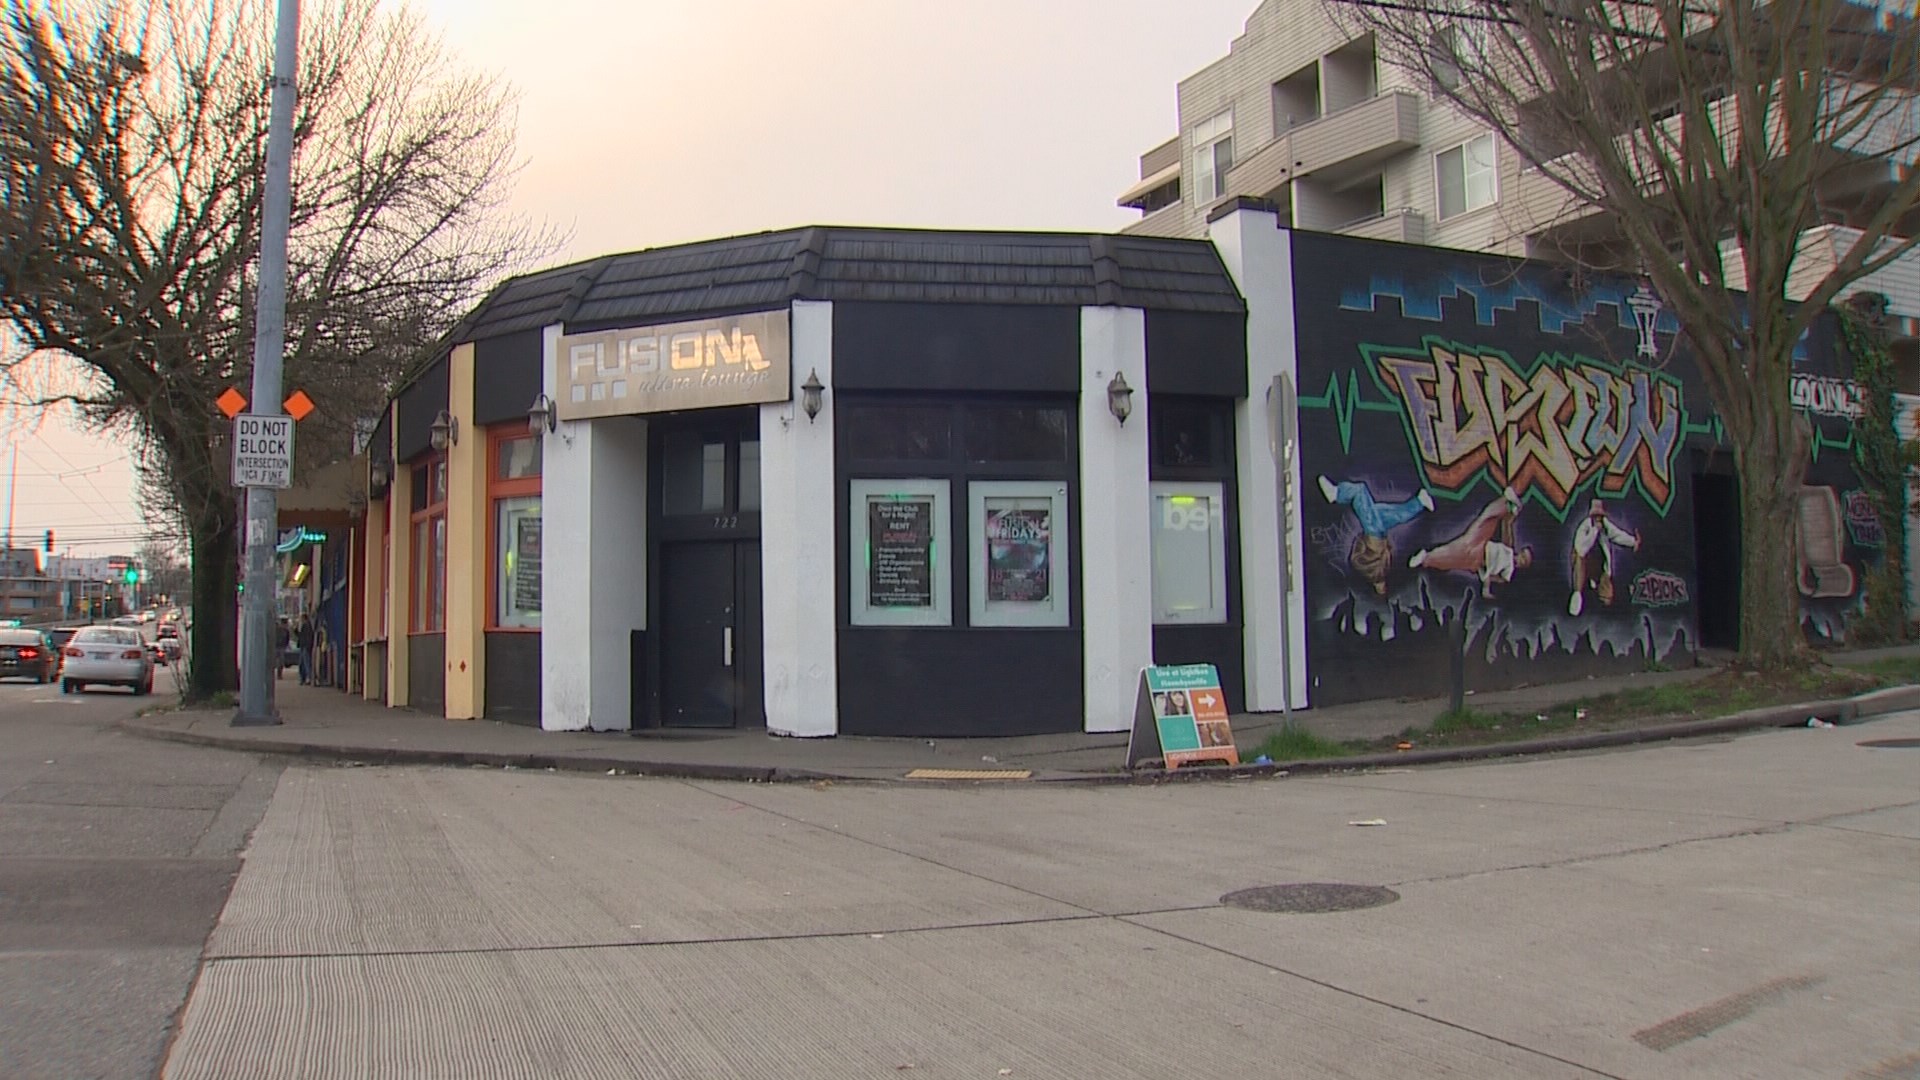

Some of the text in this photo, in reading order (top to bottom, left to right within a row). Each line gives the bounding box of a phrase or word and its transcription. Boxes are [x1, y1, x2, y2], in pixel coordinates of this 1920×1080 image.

[571, 327, 743, 380] FUSION
[639, 368, 770, 393] ultra lounge
[240, 420, 288, 436] DO NOT
[240, 439, 286, 454] BLOCK
[236, 457, 289, 469] INTERSECTION
[713, 516, 737, 529] 722
[889, 522, 910, 530] RENT
[994, 528, 1041, 539] FRIDAYS
